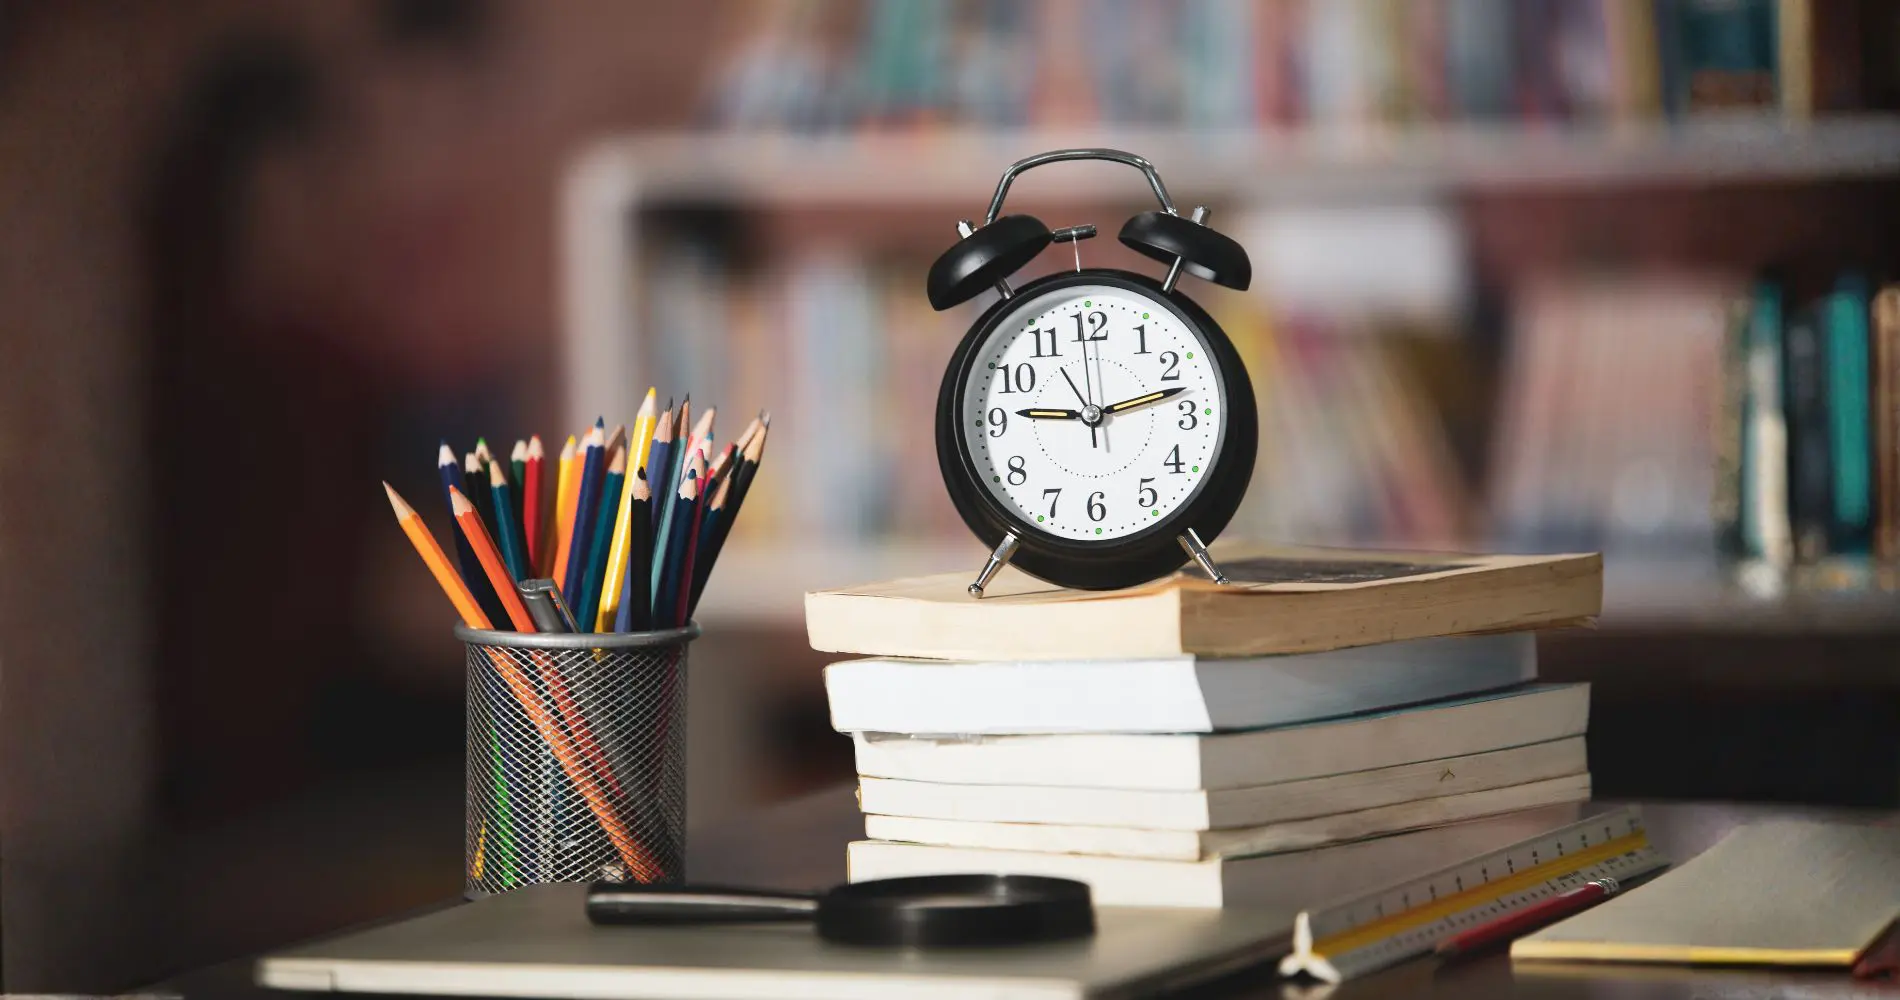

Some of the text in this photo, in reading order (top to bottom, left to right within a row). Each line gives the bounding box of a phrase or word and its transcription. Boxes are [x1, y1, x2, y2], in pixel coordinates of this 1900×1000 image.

[1070, 311, 1109, 342] 12
[1133, 325, 1152, 354] 1
[1029, 327, 1063, 357] 11
[996, 363, 1036, 394] 10
[1159, 351, 1180, 381] 2
[988, 407, 1007, 438] 9
[1178, 400, 1197, 430] 3
[1007, 455, 1027, 486] 8
[1164, 444, 1185, 474] 4
[1042, 488, 1062, 518] 7
[1087, 491, 1106, 521] 6
[1138, 477, 1158, 507] 5
